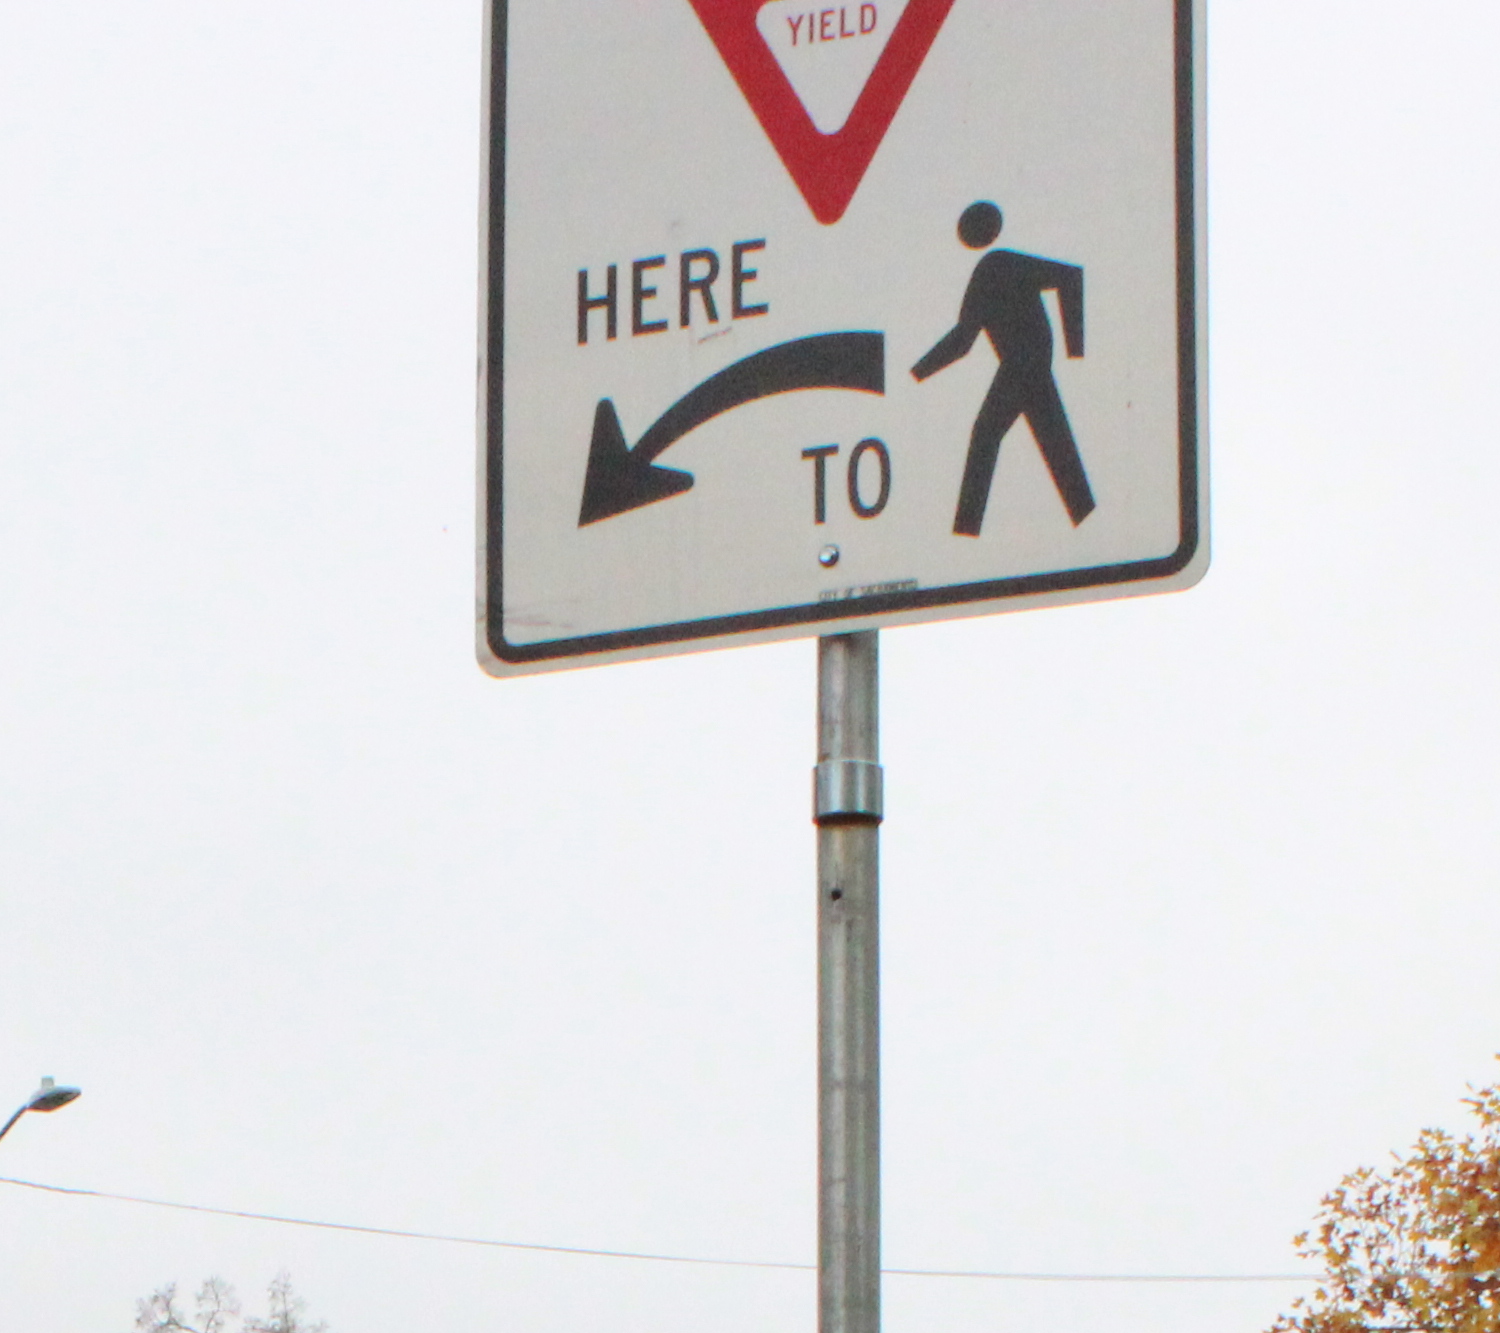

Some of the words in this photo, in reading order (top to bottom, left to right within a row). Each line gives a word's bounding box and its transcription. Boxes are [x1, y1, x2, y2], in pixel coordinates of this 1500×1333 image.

[786, 3, 877, 47] YIELD
[577, 237, 769, 346] HERE
[801, 438, 892, 525] TO
